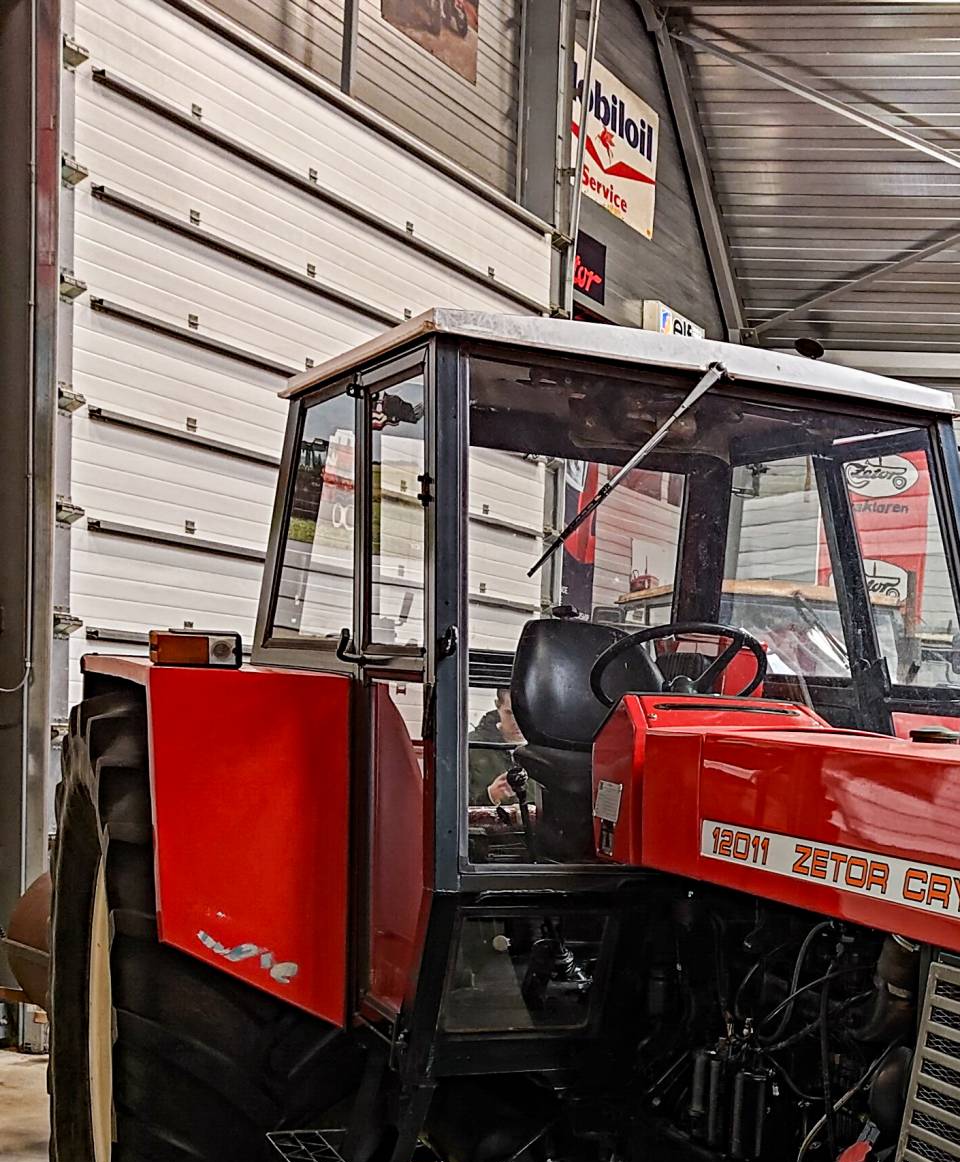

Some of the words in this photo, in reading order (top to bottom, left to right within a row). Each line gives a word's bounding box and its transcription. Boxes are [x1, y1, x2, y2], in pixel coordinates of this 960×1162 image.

[573, 62, 653, 162] obiloil
[582, 163, 628, 213] Service
[712, 826, 770, 866] 12011
[792, 844, 890, 894] ZETOR
